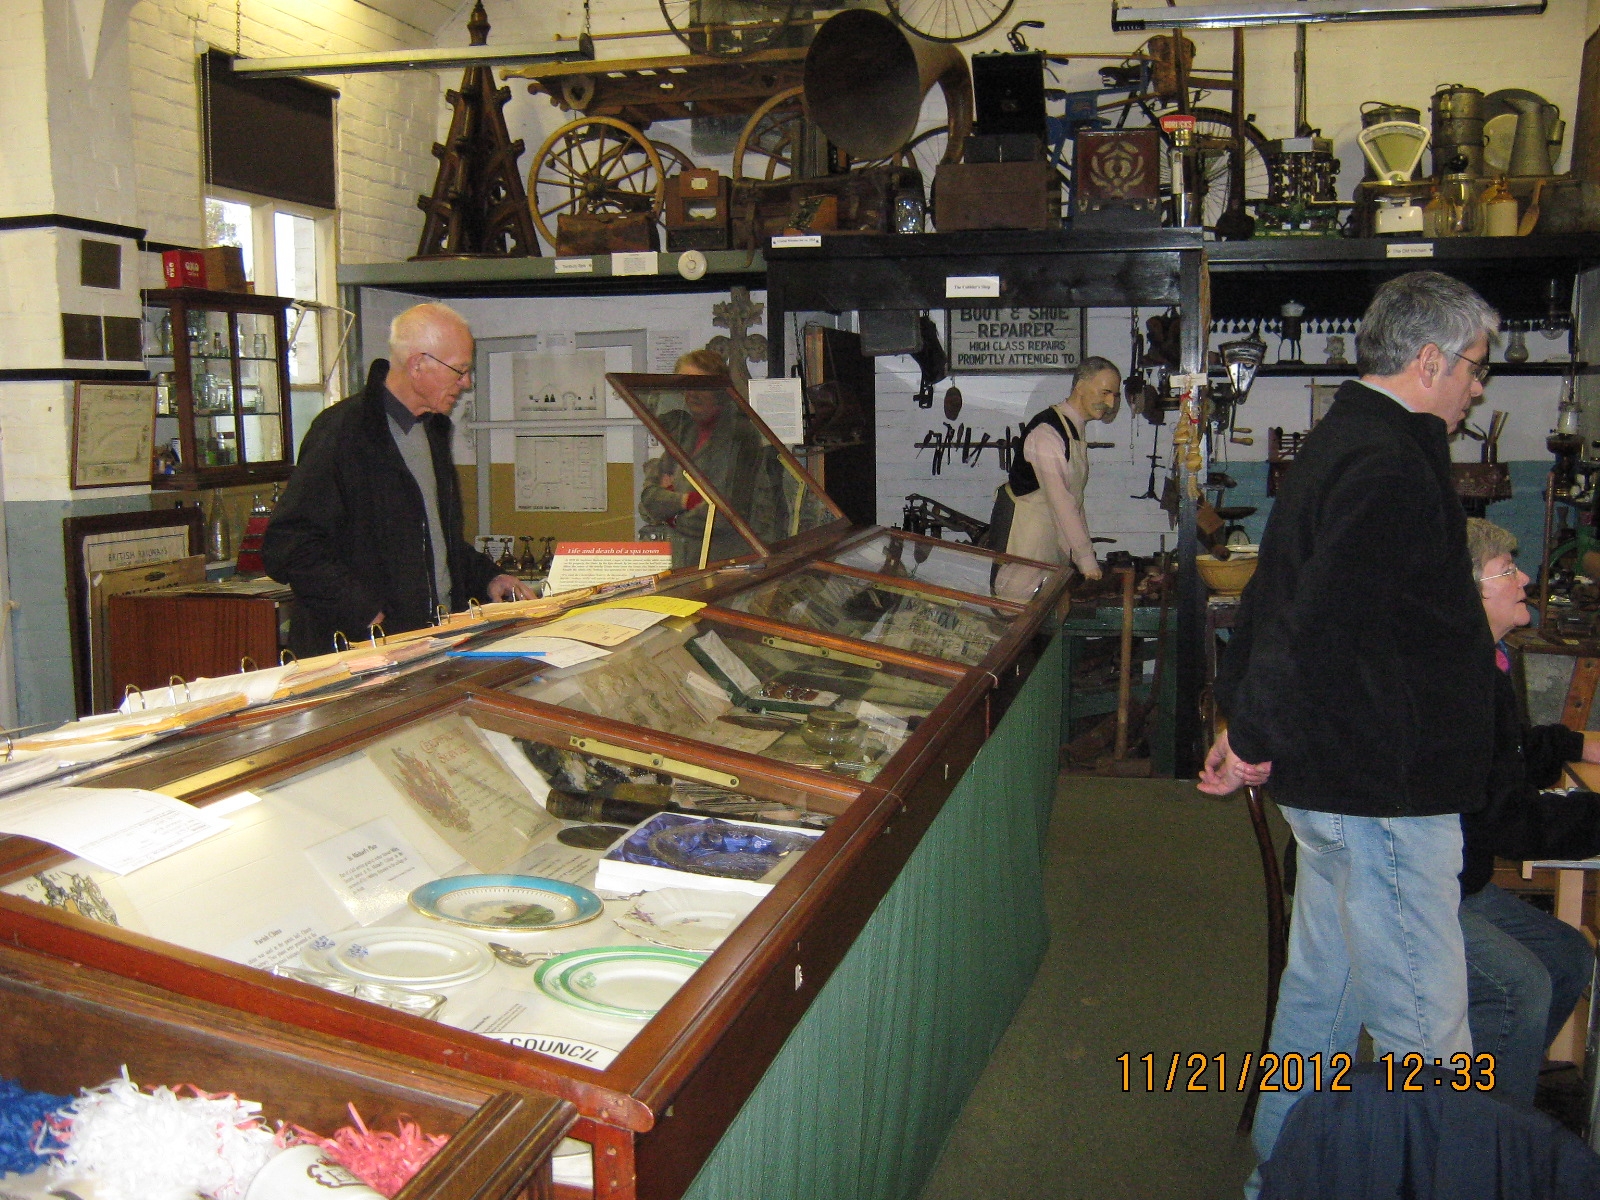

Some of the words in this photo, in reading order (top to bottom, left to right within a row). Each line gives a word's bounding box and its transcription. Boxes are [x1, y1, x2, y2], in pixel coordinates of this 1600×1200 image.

[168, 262, 176, 278] OXO
[960, 307, 1000, 321] BOOT
[1028, 307, 1069, 320] SHOE
[977, 322, 1055, 338] REPAIRER
[969, 341, 990, 352] HIGH
[992, 341, 1025, 351] CLASS
[1027, 340, 1066, 351] REPAIRS
[957, 353, 1006, 365] PROMPTLY
[1008, 353, 1059, 365] ATTENDED
[108, 551, 136, 562] BRITISH
